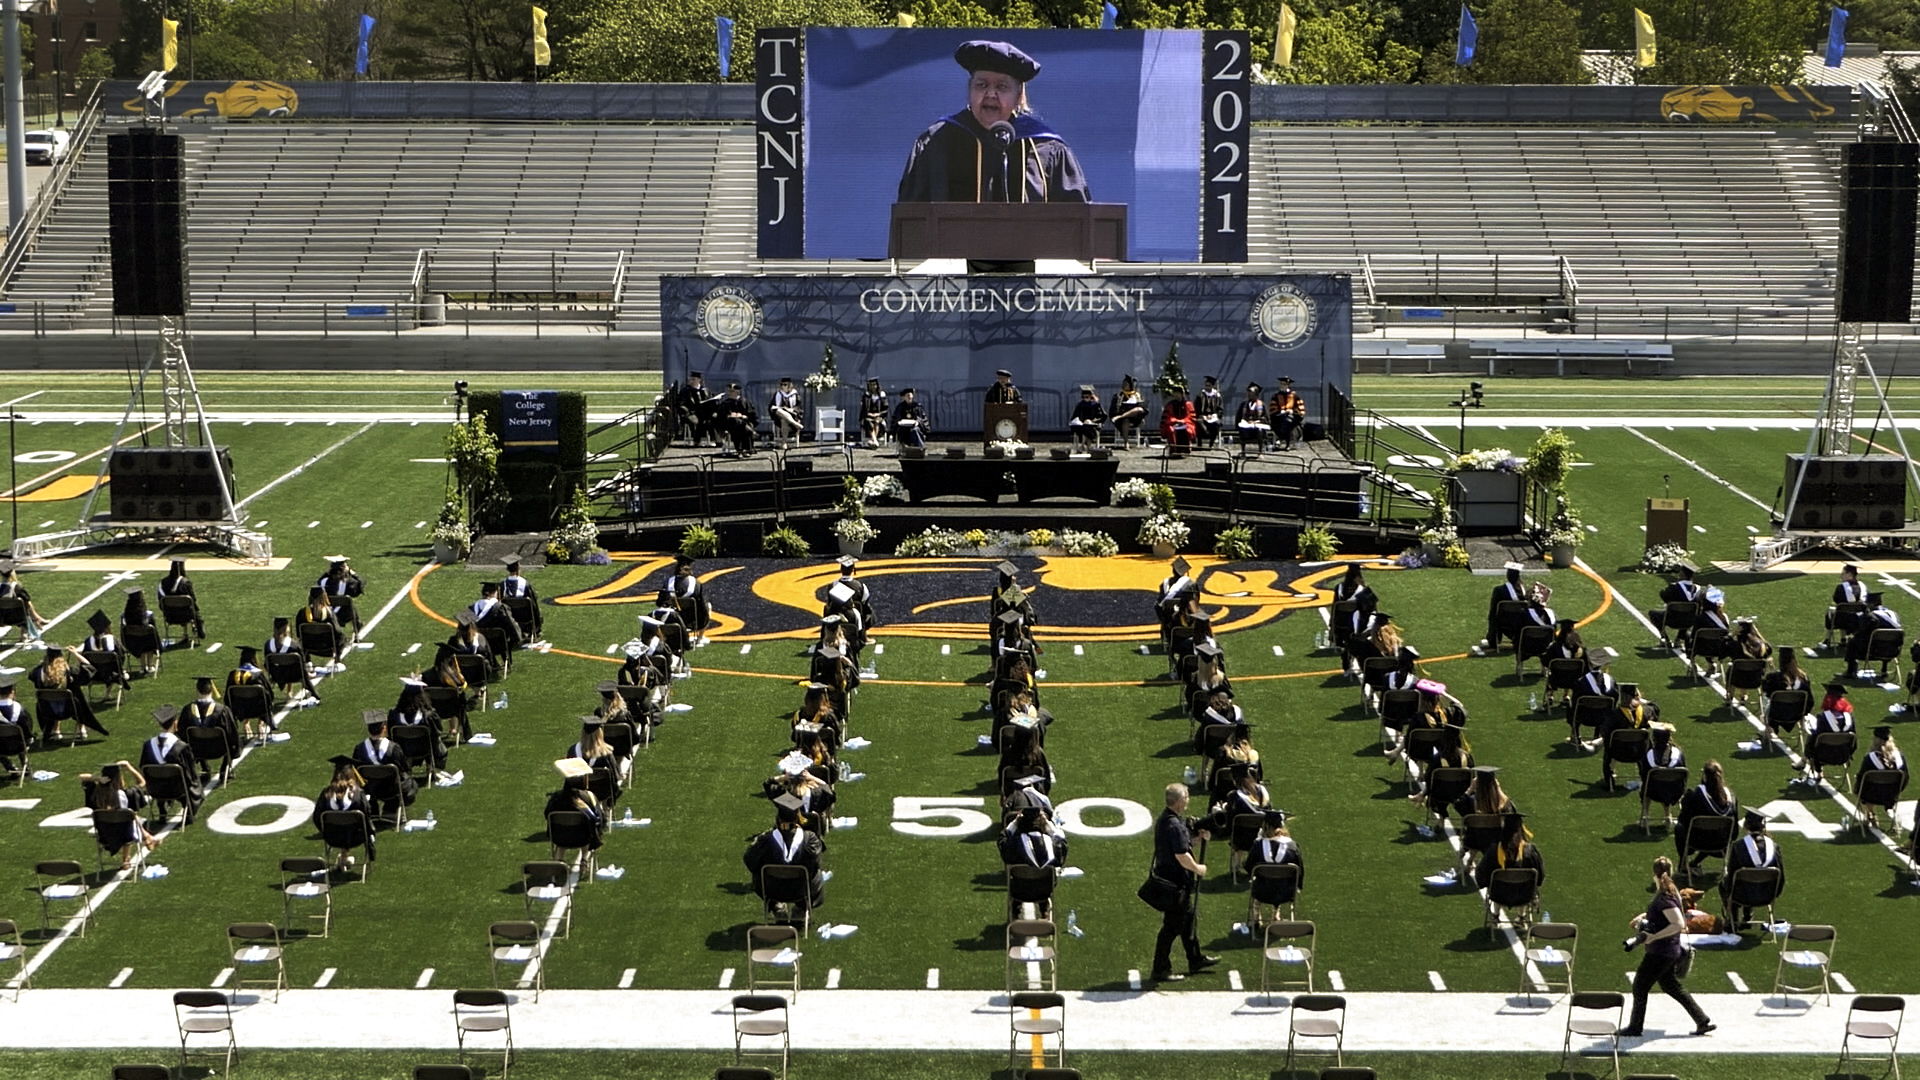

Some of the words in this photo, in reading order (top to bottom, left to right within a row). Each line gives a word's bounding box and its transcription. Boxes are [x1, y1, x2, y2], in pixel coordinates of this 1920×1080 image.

[759, 38, 797, 226] TCNJ
[1211, 39, 1243, 233] 2021
[860, 288, 1152, 313] COMMENCEMENT
[521, 391, 538, 400] The
[515, 401, 545, 411] College
[508, 418, 527, 426] New
[529, 418, 552, 427] Jersey
